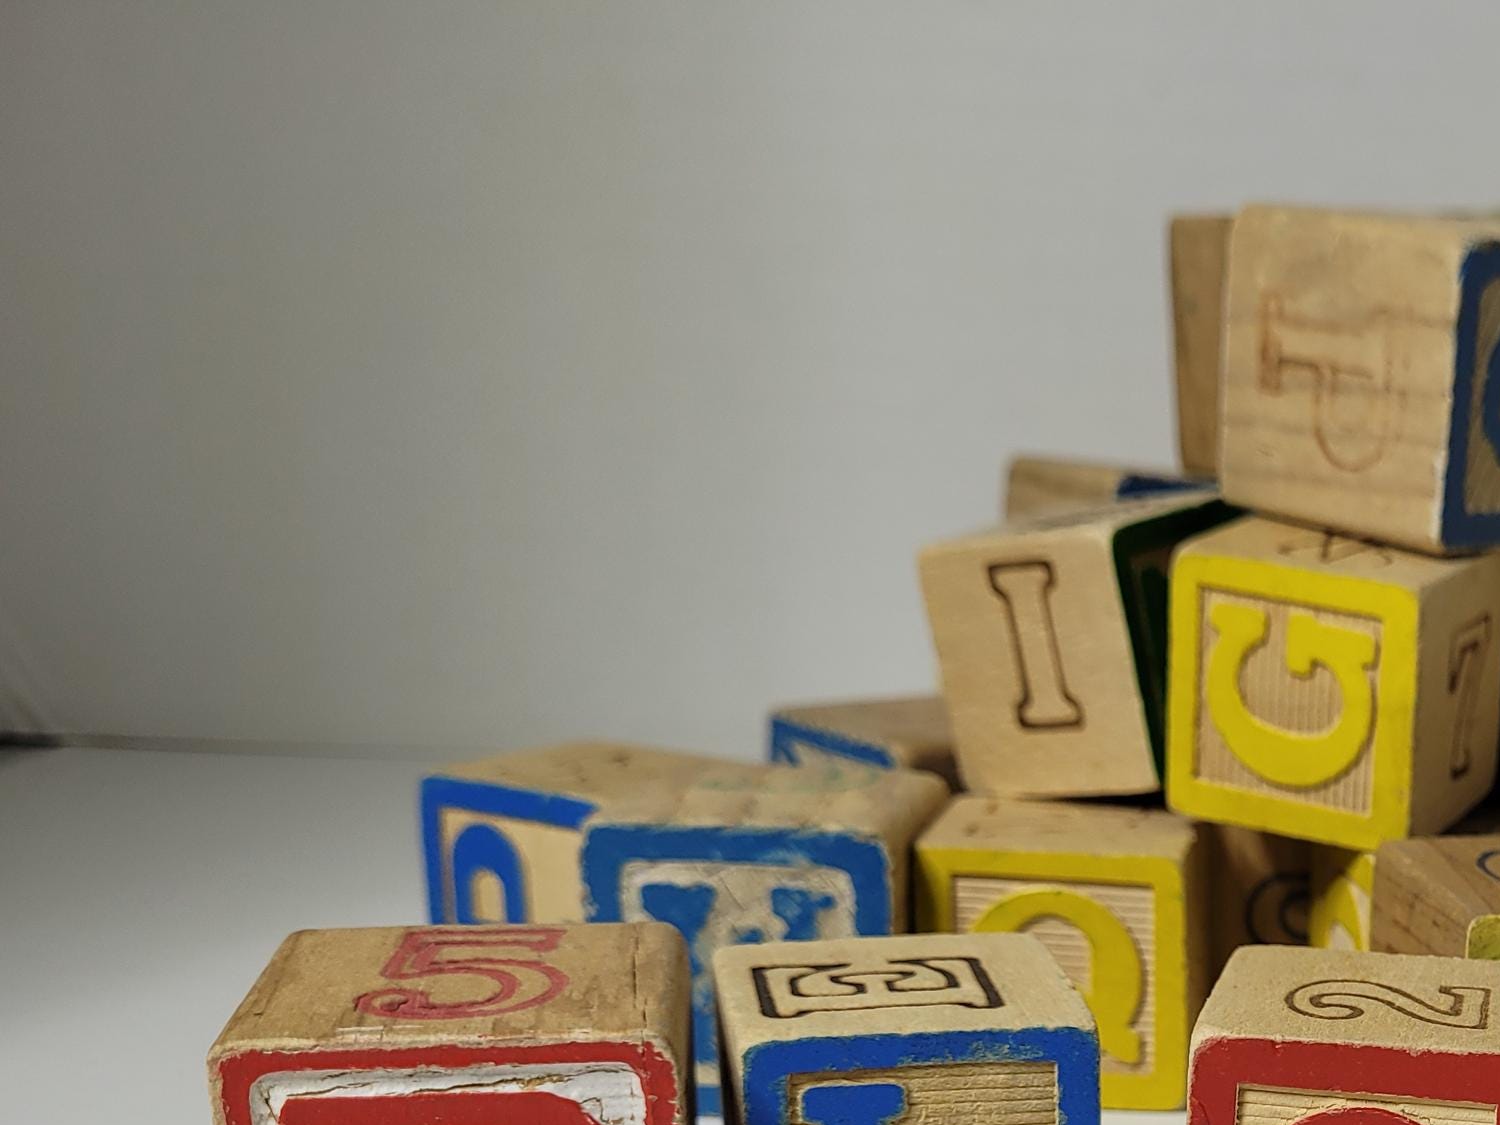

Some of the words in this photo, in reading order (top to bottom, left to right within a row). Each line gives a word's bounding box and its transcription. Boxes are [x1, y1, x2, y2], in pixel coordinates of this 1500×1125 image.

[1260, 291, 1410, 475] P
[986, 559, 1085, 731] I
[1207, 605, 1379, 790] G
[358, 928, 571, 1019] 5
[752, 956, 1004, 1019] E
[970, 889, 1143, 1065] Q
[1285, 978, 1492, 1030] 2
